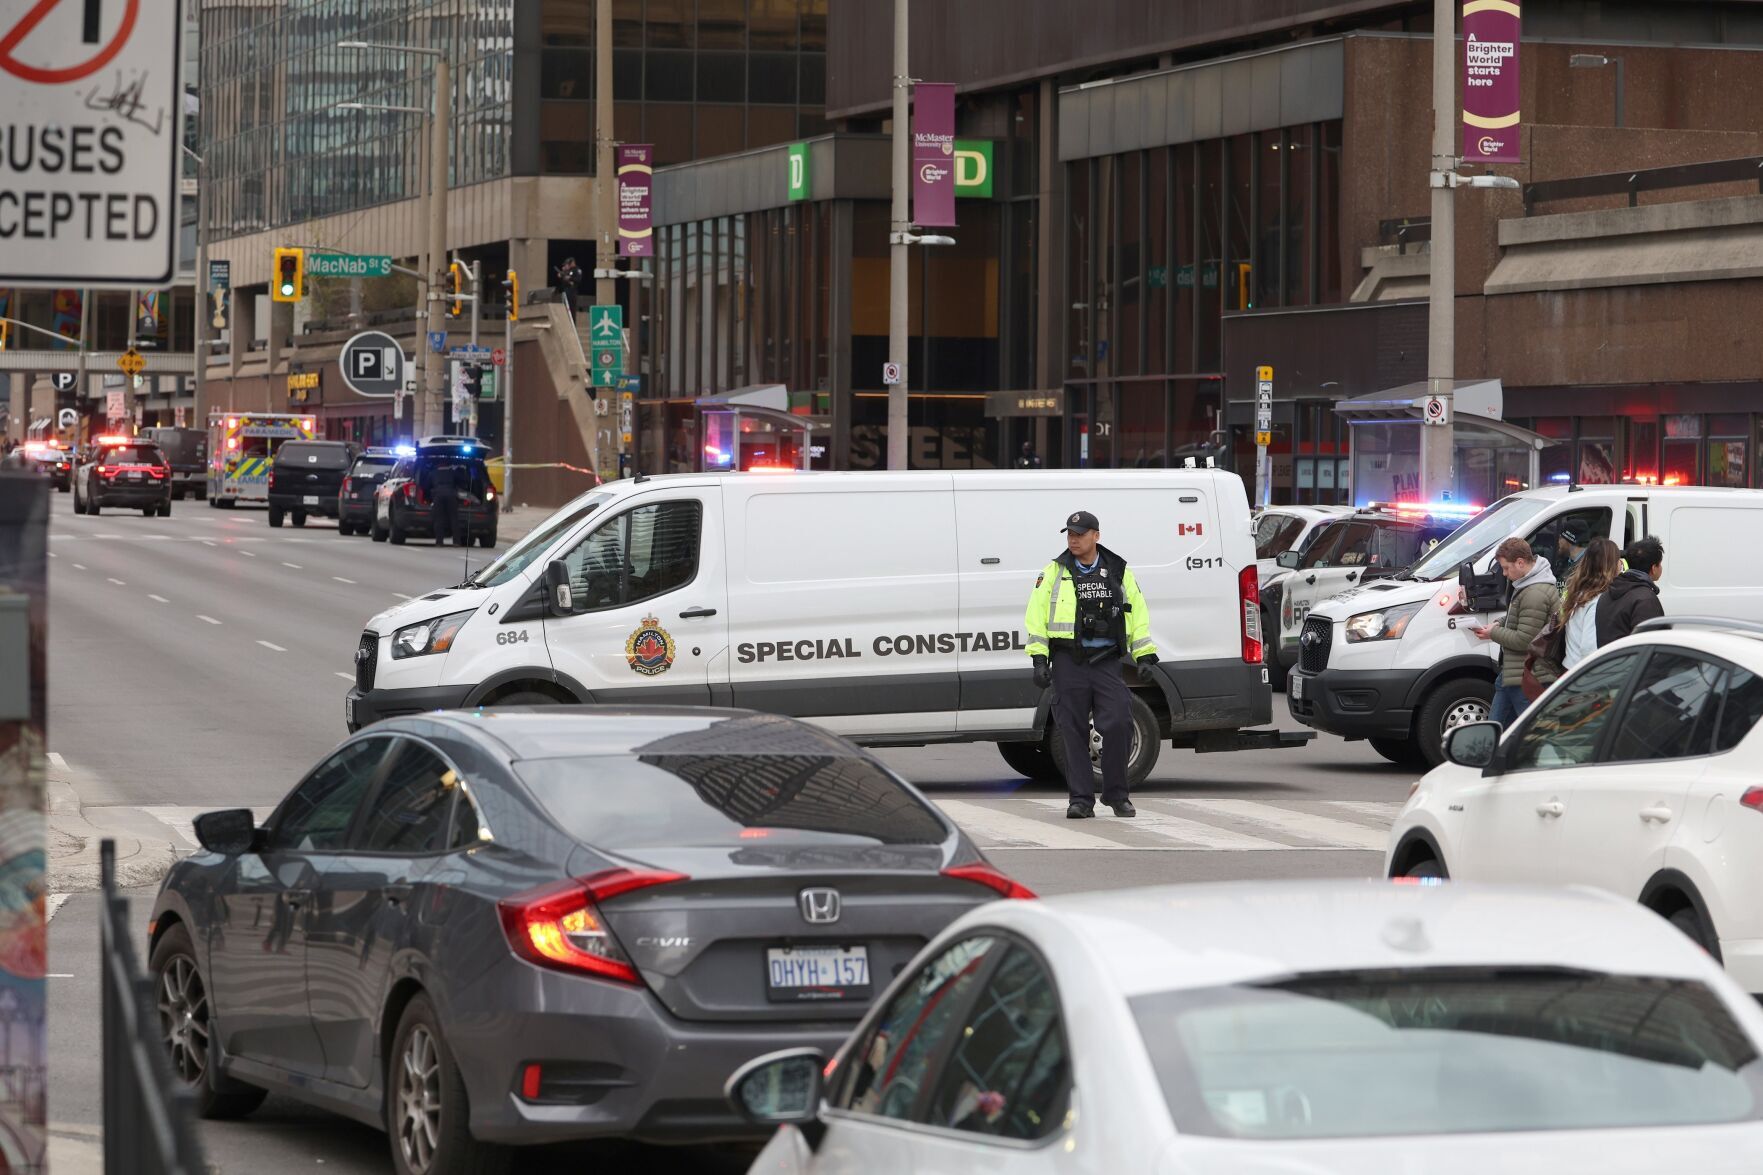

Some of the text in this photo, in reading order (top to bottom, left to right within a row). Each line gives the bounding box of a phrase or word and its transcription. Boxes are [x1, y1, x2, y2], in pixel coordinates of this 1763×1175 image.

[1468, 33, 1477, 42] A
[1468, 44, 1513, 55] Brighter
[1468, 55, 1501, 64] World
[1468, 66, 1501, 76] starts
[1468, 77, 1493, 86] here
[915, 133, 954, 142] McMaster
[0, 125, 124, 174] USES
[1483, 140, 1504, 149] Brighter
[954, 150, 987, 186] D
[309, 258, 392, 274] MacNab St S
[358, 353, 376, 375] P
[59, 373, 72, 388] P
[1192, 557, 1223, 569] 911
[1077, 582, 1107, 592] SPECIAL
[1079, 590, 1112, 599] ONSTABLE
[496, 630, 529, 646] 684
[636, 631, 665, 646] HAMILTON
[737, 630, 1026, 664] SPECIAL CONSTABL
[636, 665, 665, 675] POLICE
[771, 957, 866, 988] DHYH 157
